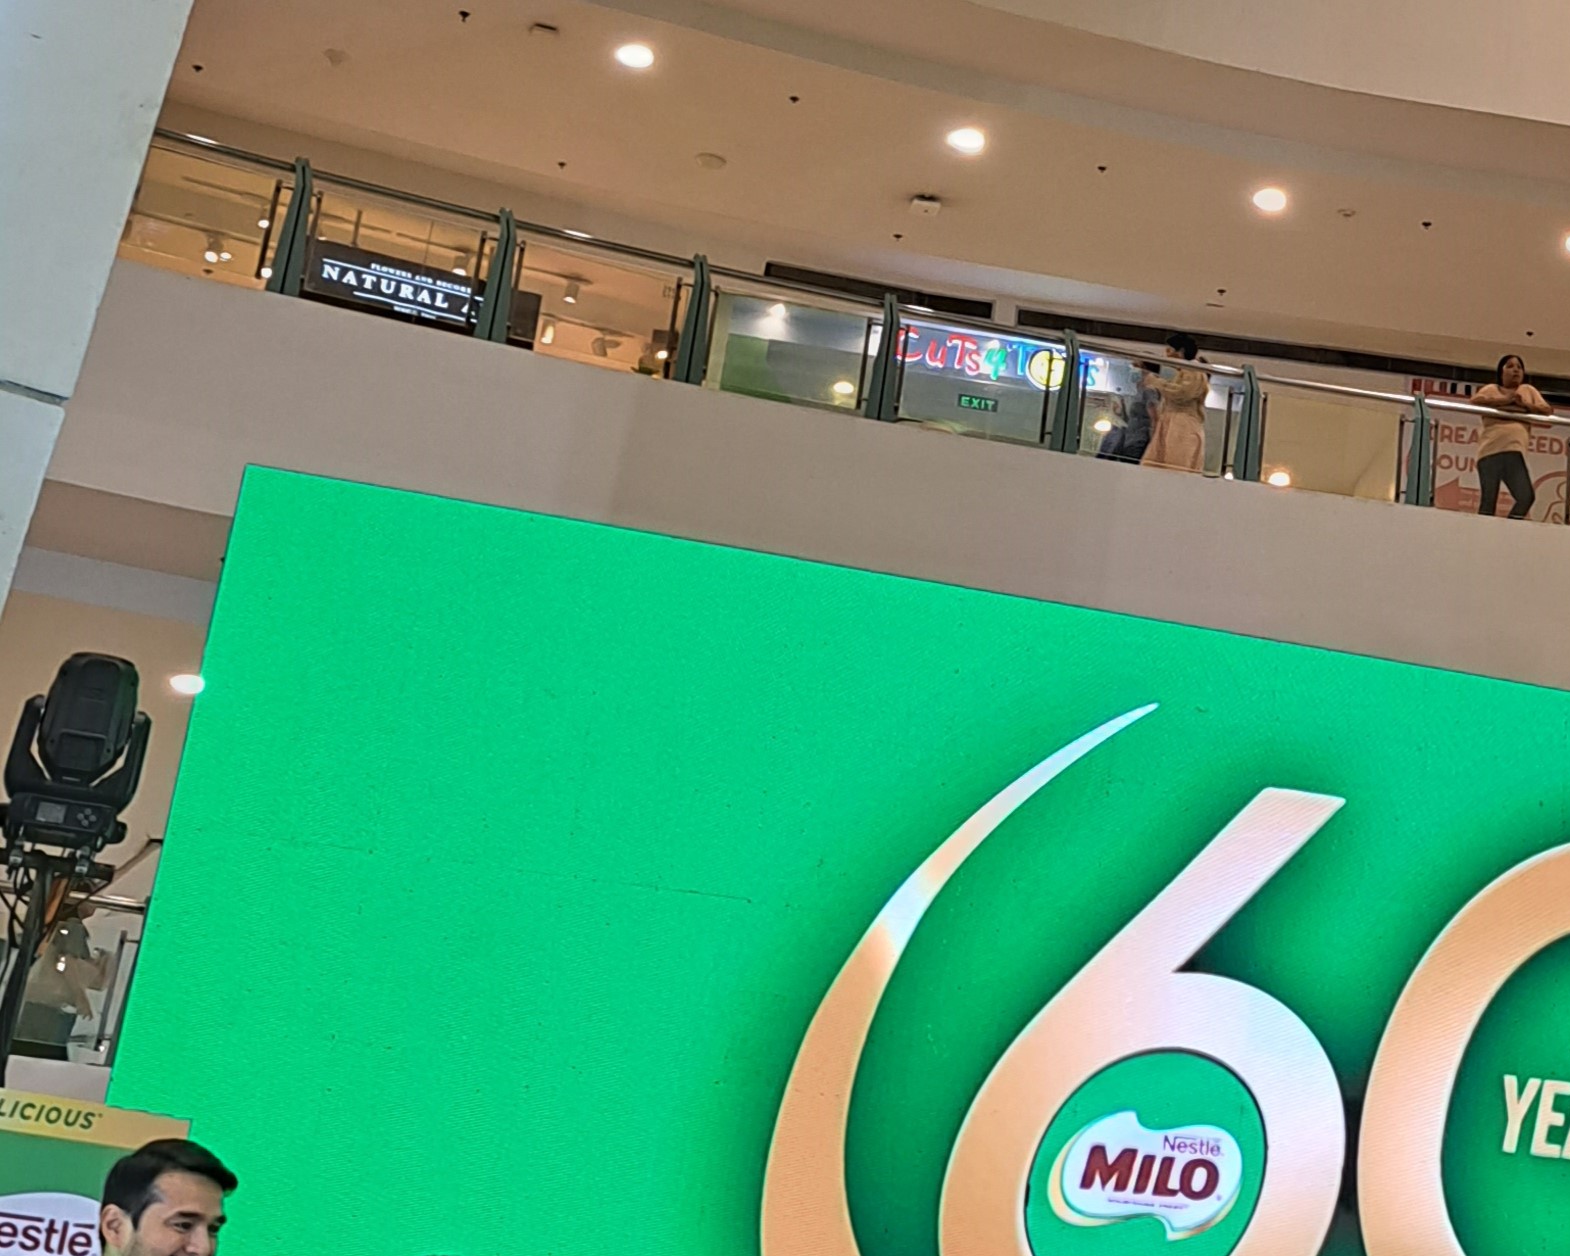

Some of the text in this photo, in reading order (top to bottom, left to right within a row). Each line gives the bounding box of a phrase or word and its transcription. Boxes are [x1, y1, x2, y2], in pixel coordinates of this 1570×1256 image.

[322, 264, 448, 308] NATURAL
[960, 396, 995, 410] EXIT
[1079, 1145, 1220, 1201] MILO
